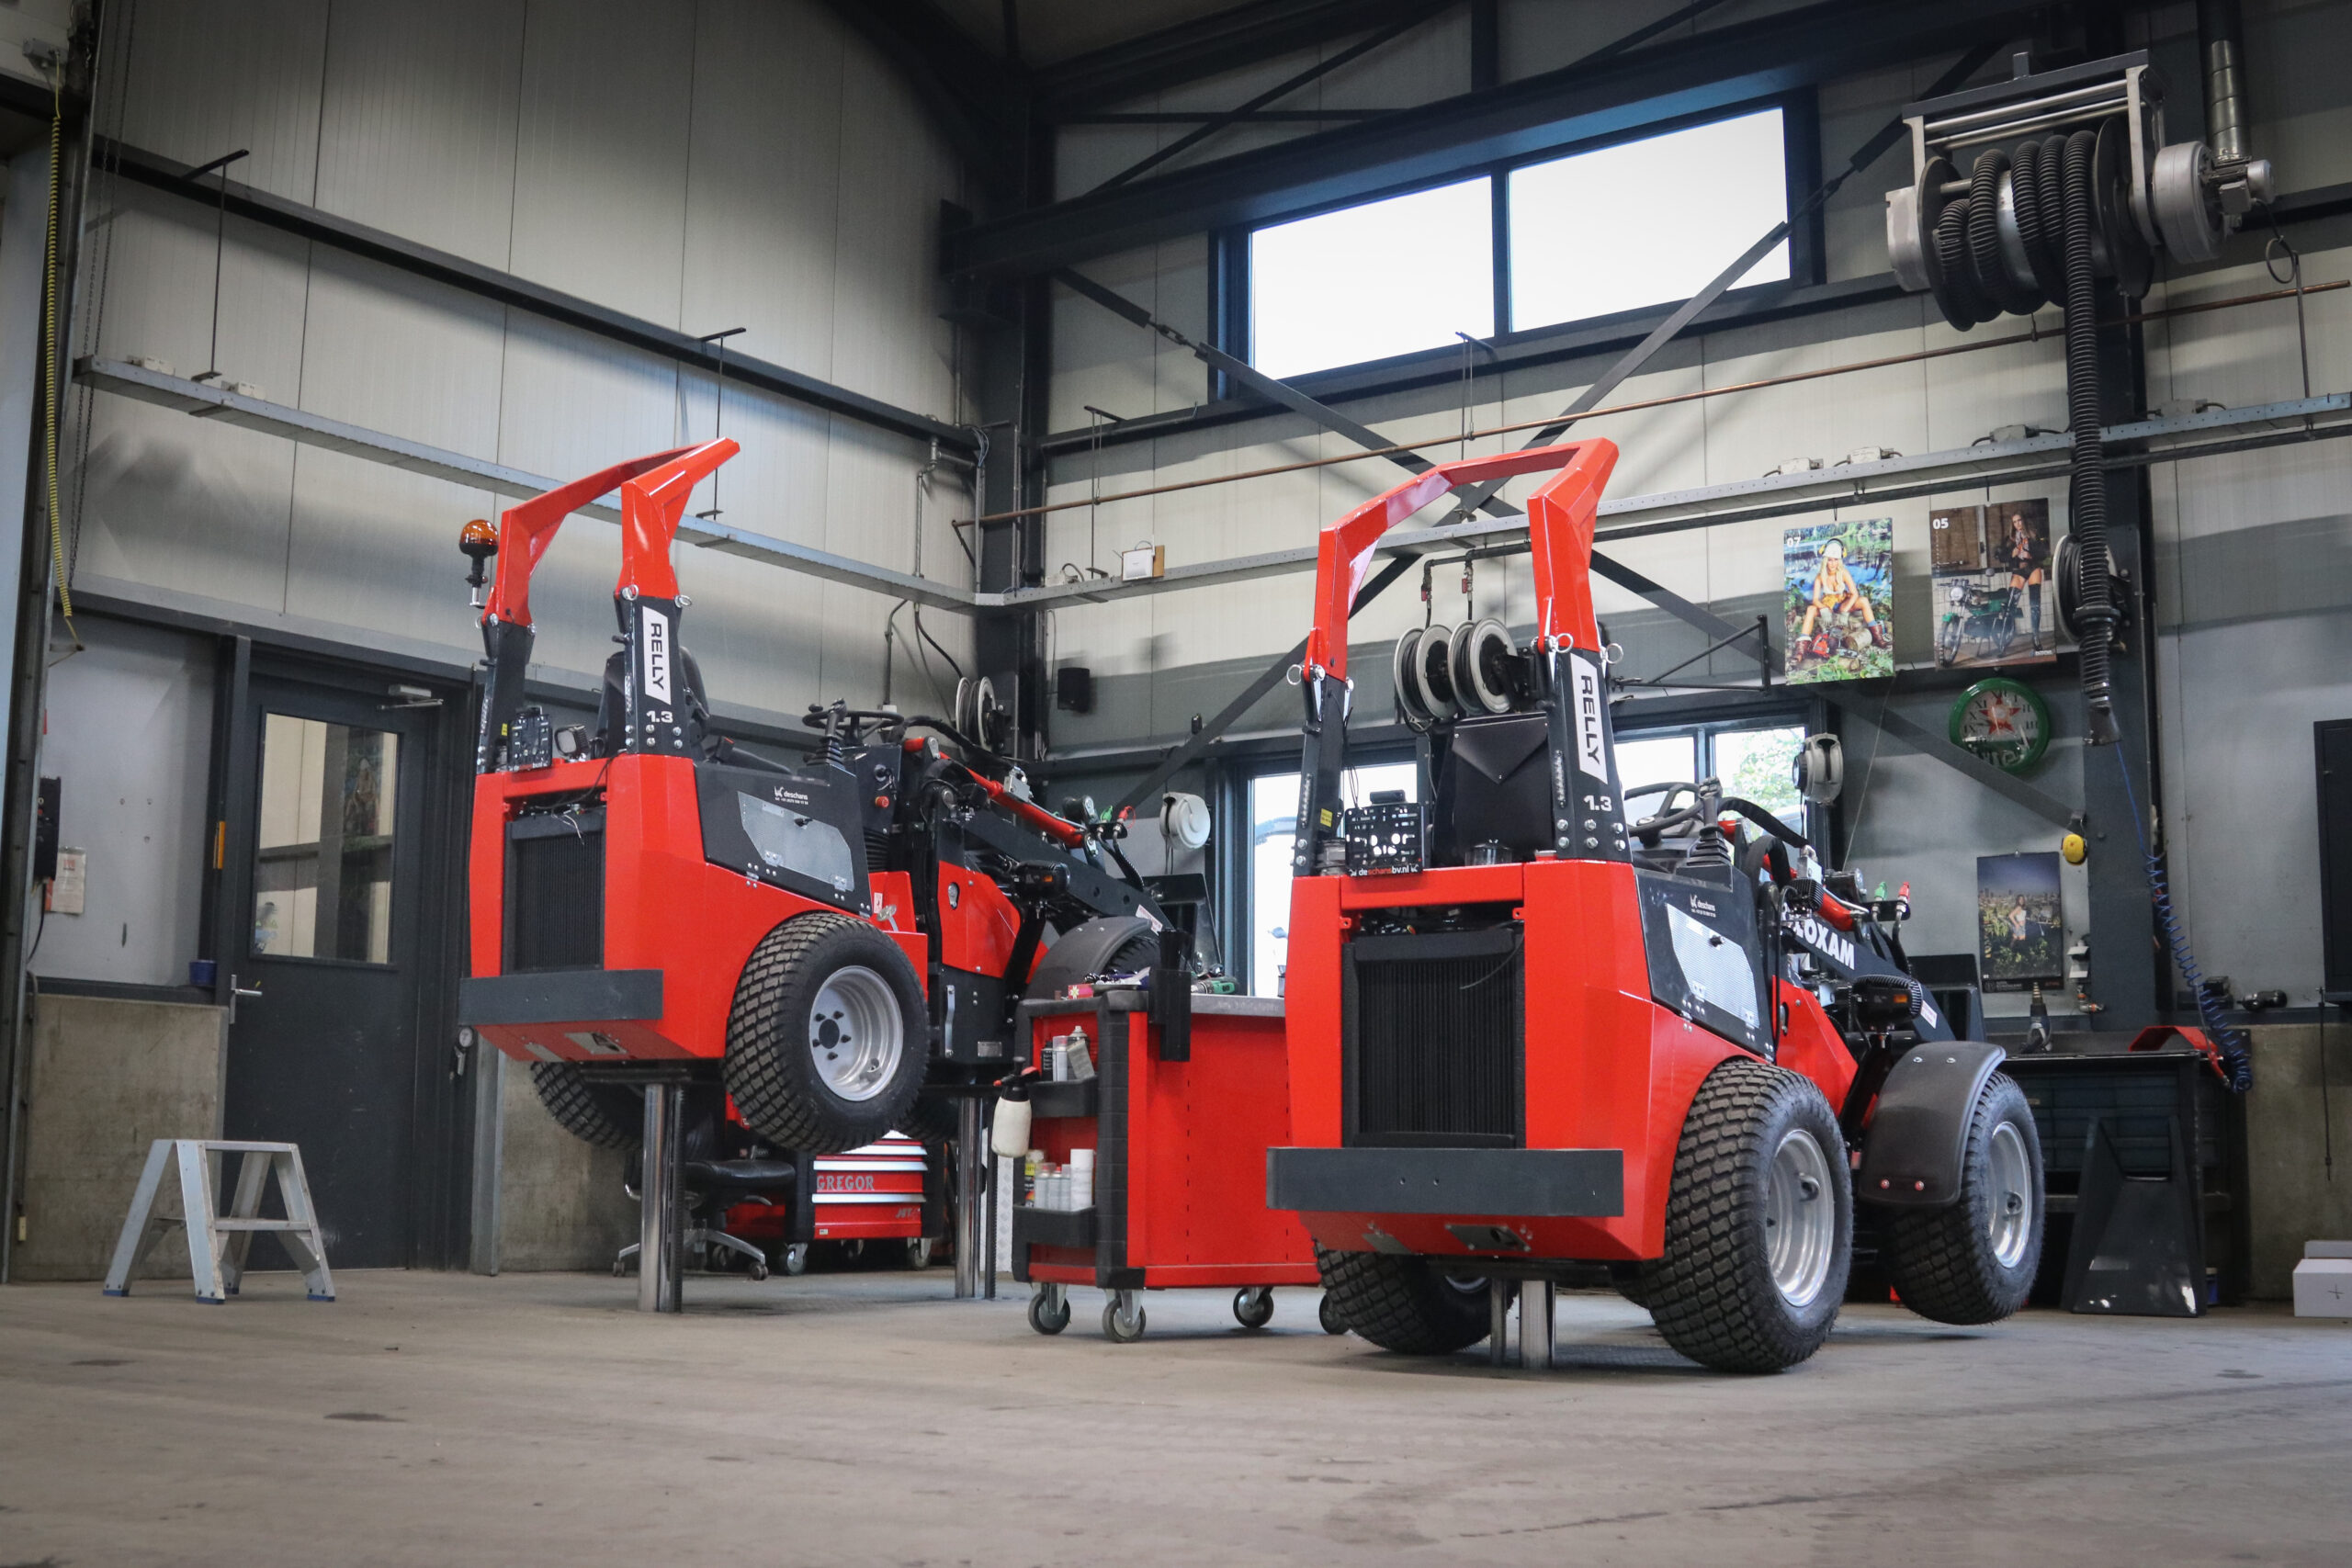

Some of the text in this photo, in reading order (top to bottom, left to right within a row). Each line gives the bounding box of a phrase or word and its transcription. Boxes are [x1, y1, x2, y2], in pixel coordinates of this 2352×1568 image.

[1932, 518, 1949, 530] 05
[1786, 536, 1801, 547] 07
[650, 623, 664, 691] RELLY
[646, 710, 673, 723] 1.3
[1580, 675, 1600, 765] RELLY
[1583, 795, 1612, 811] 1.3
[1358, 863, 1409, 876] deschansbv.nl
[816, 1175, 875, 1191] GREGOR
